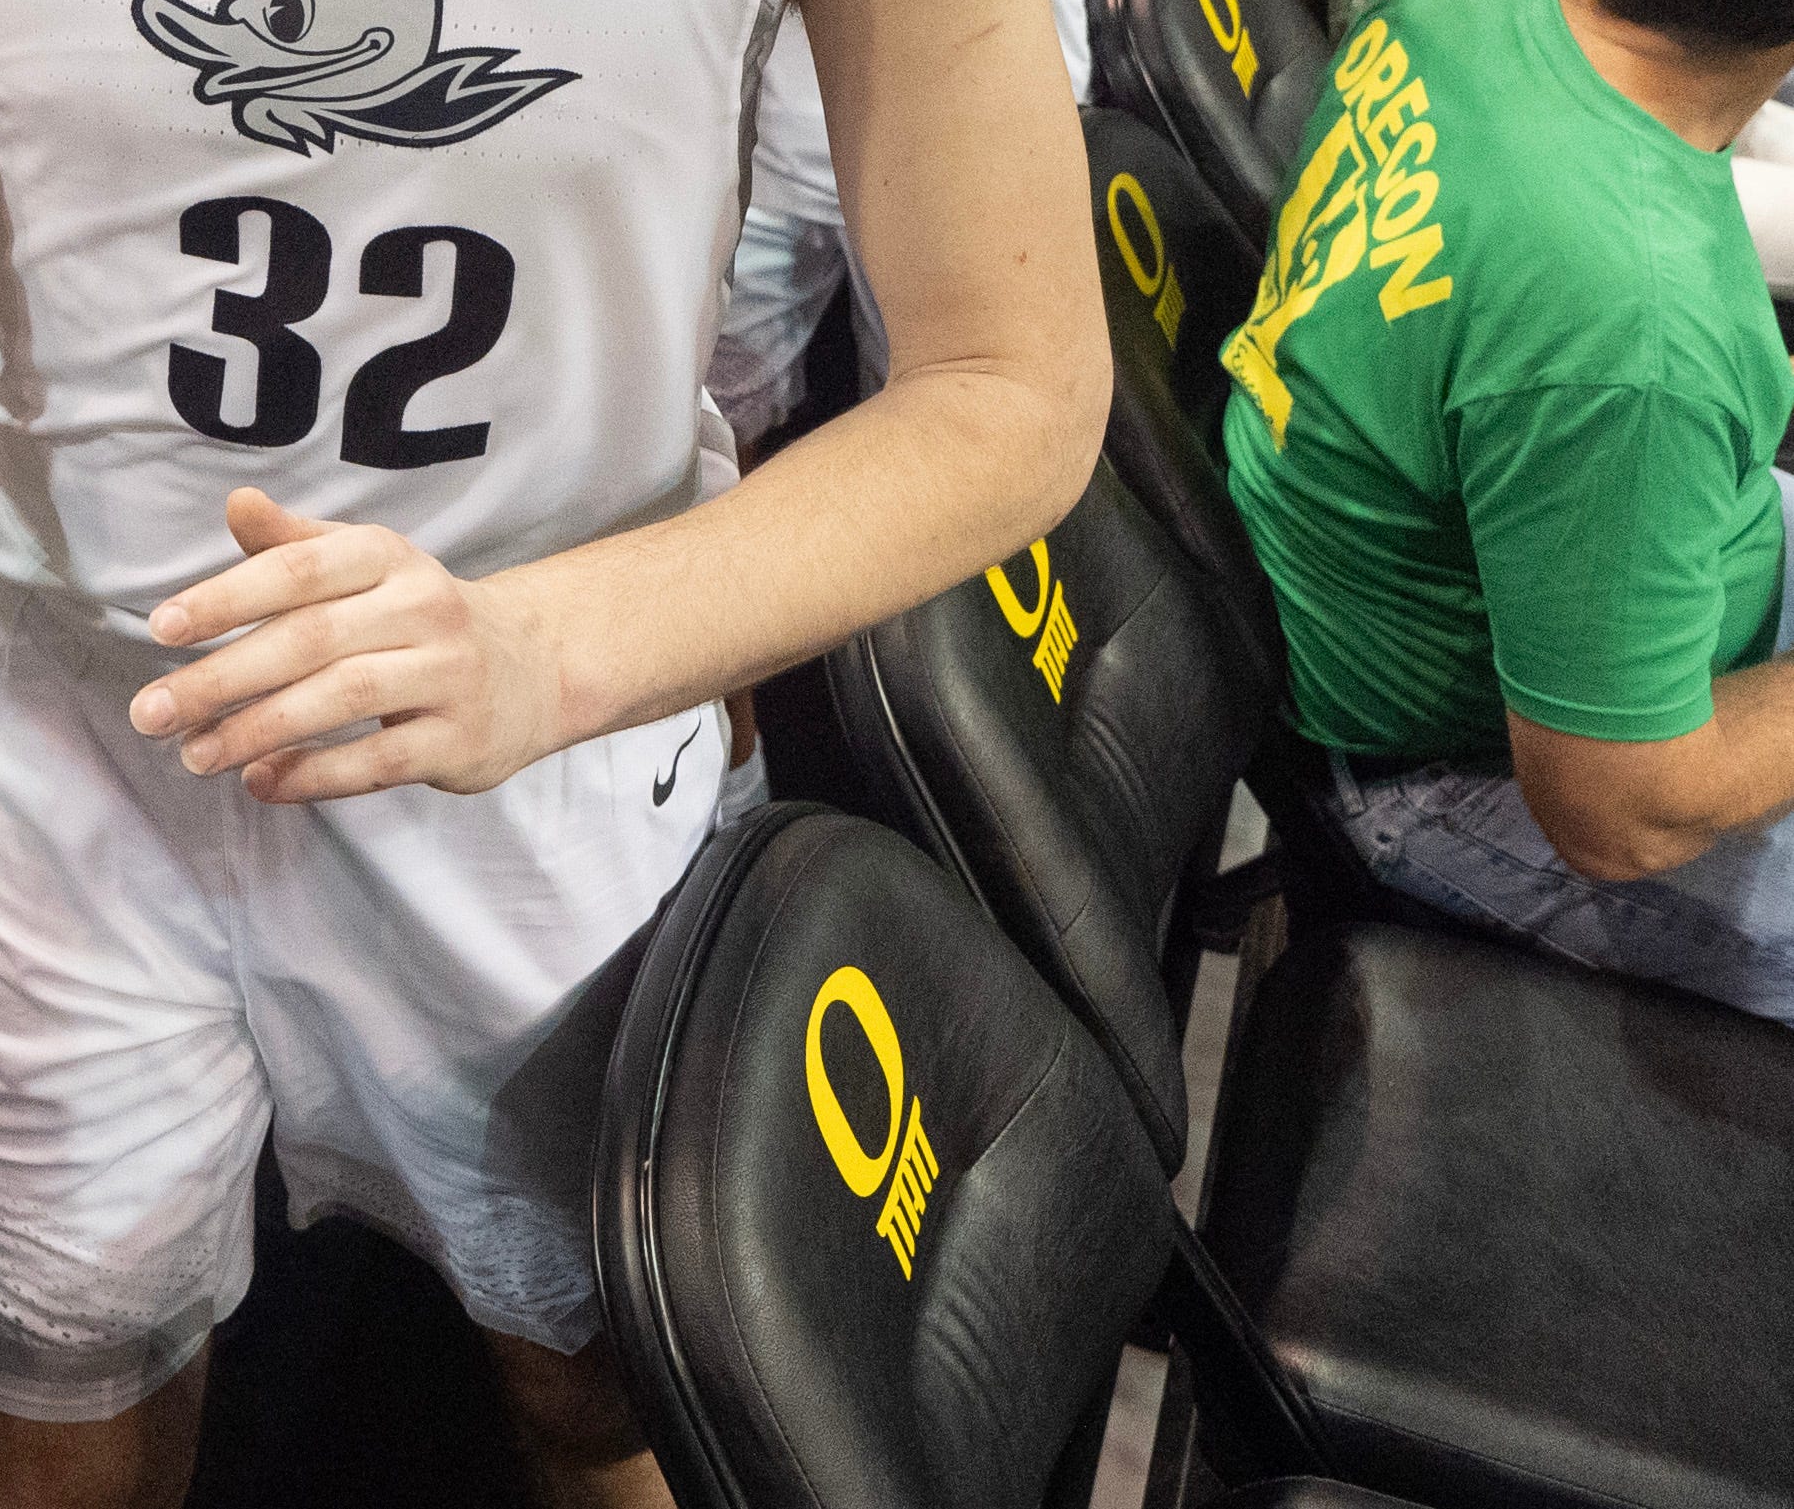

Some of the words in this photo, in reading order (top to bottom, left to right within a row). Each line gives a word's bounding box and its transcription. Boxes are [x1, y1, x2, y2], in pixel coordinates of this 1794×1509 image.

[1334, 17, 1453, 323] OREGON
[166, 193, 517, 471] 32
[805, 965, 904, 1198] O
